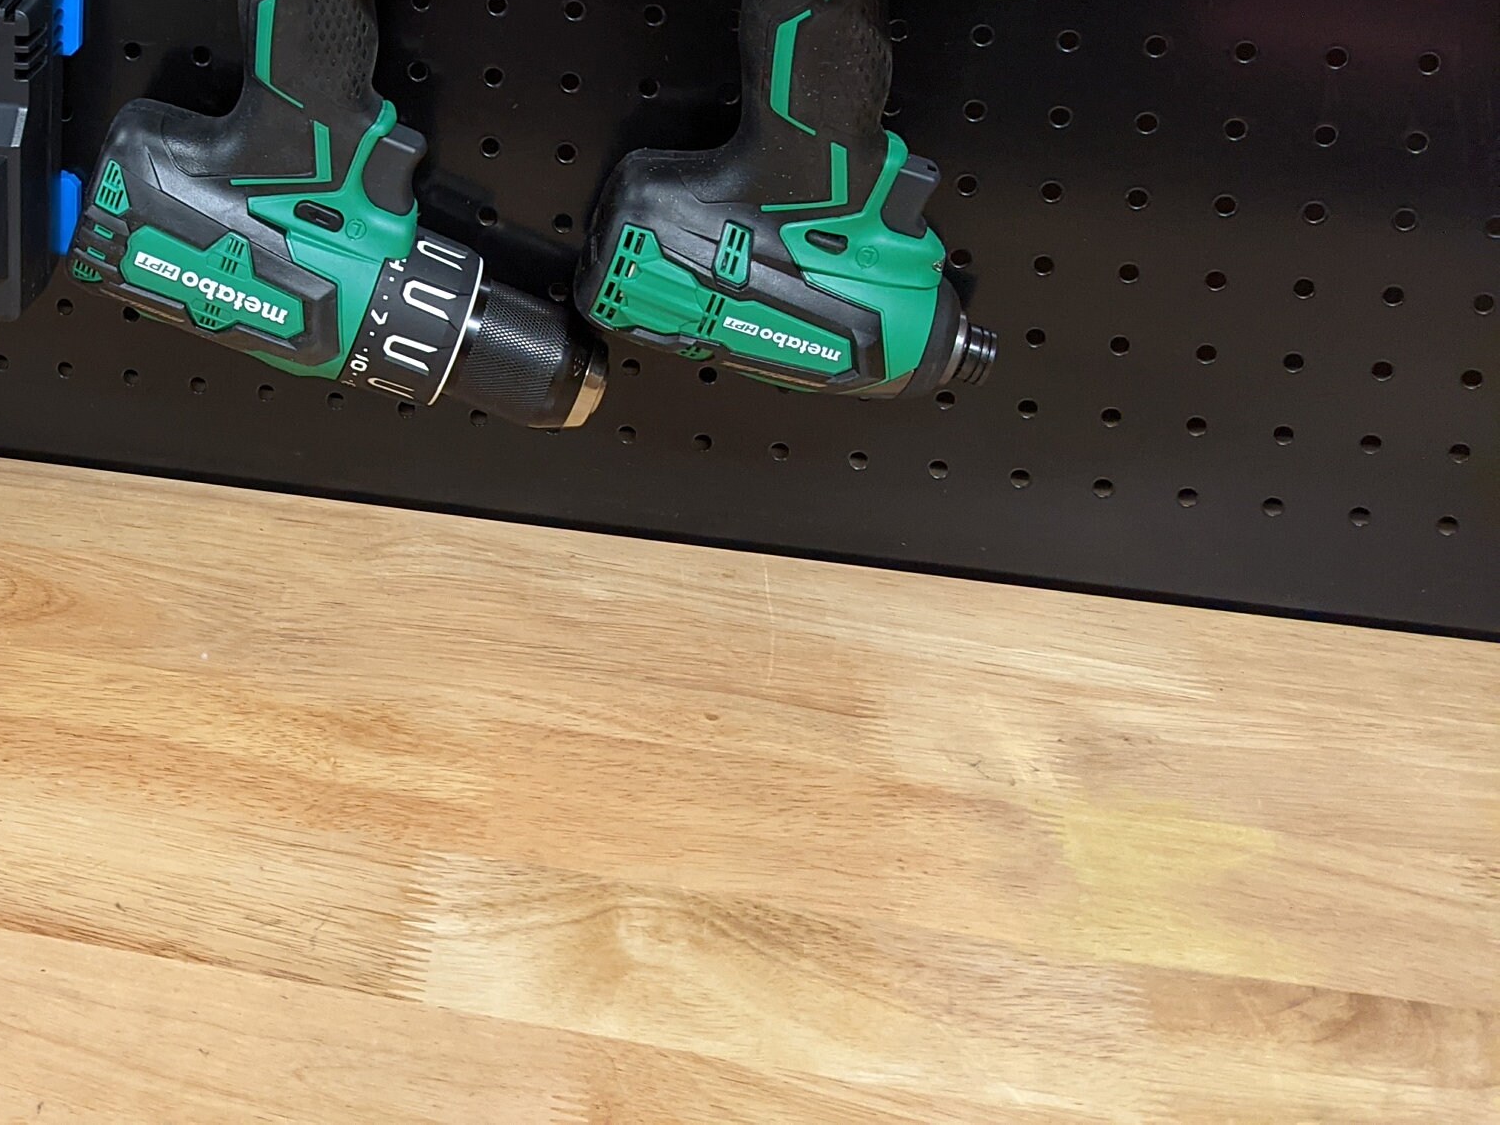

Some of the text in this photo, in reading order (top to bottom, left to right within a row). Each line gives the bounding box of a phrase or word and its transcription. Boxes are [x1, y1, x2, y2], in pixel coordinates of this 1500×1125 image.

[136, 254, 288, 324] metabo HPT
[350, 354, 369, 372] 10
[371, 309, 389, 326] 7
[724, 318, 841, 361] metabo HPT
